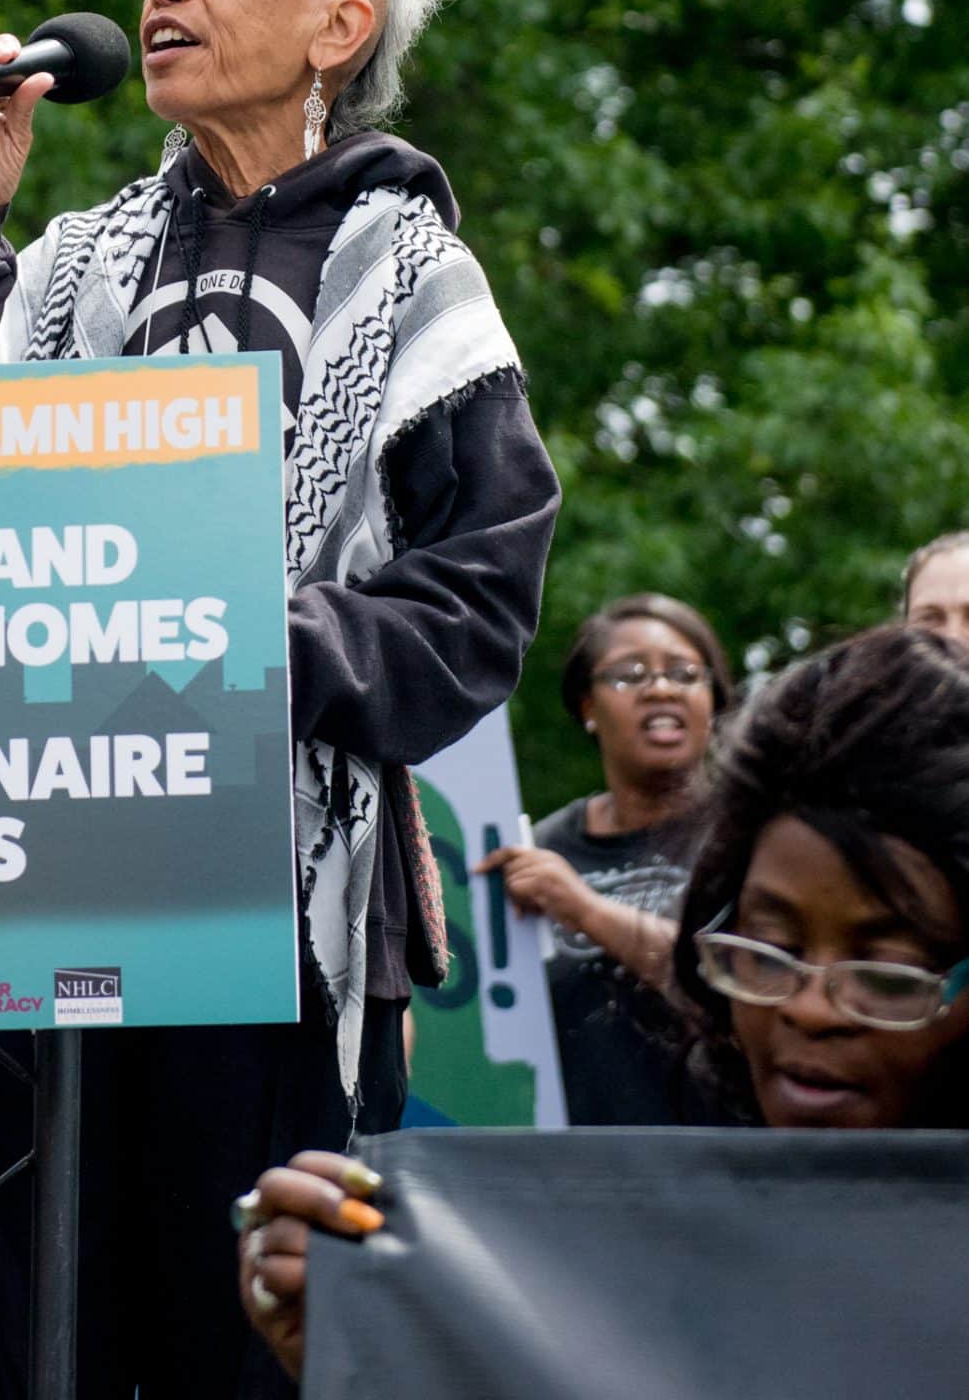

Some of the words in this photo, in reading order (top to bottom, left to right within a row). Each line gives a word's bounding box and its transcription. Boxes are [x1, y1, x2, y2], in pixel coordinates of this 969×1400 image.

[200, 274, 227, 292] ONE
[105, 397, 243, 453] HIGH
[57, 979, 114, 997] NHLC
